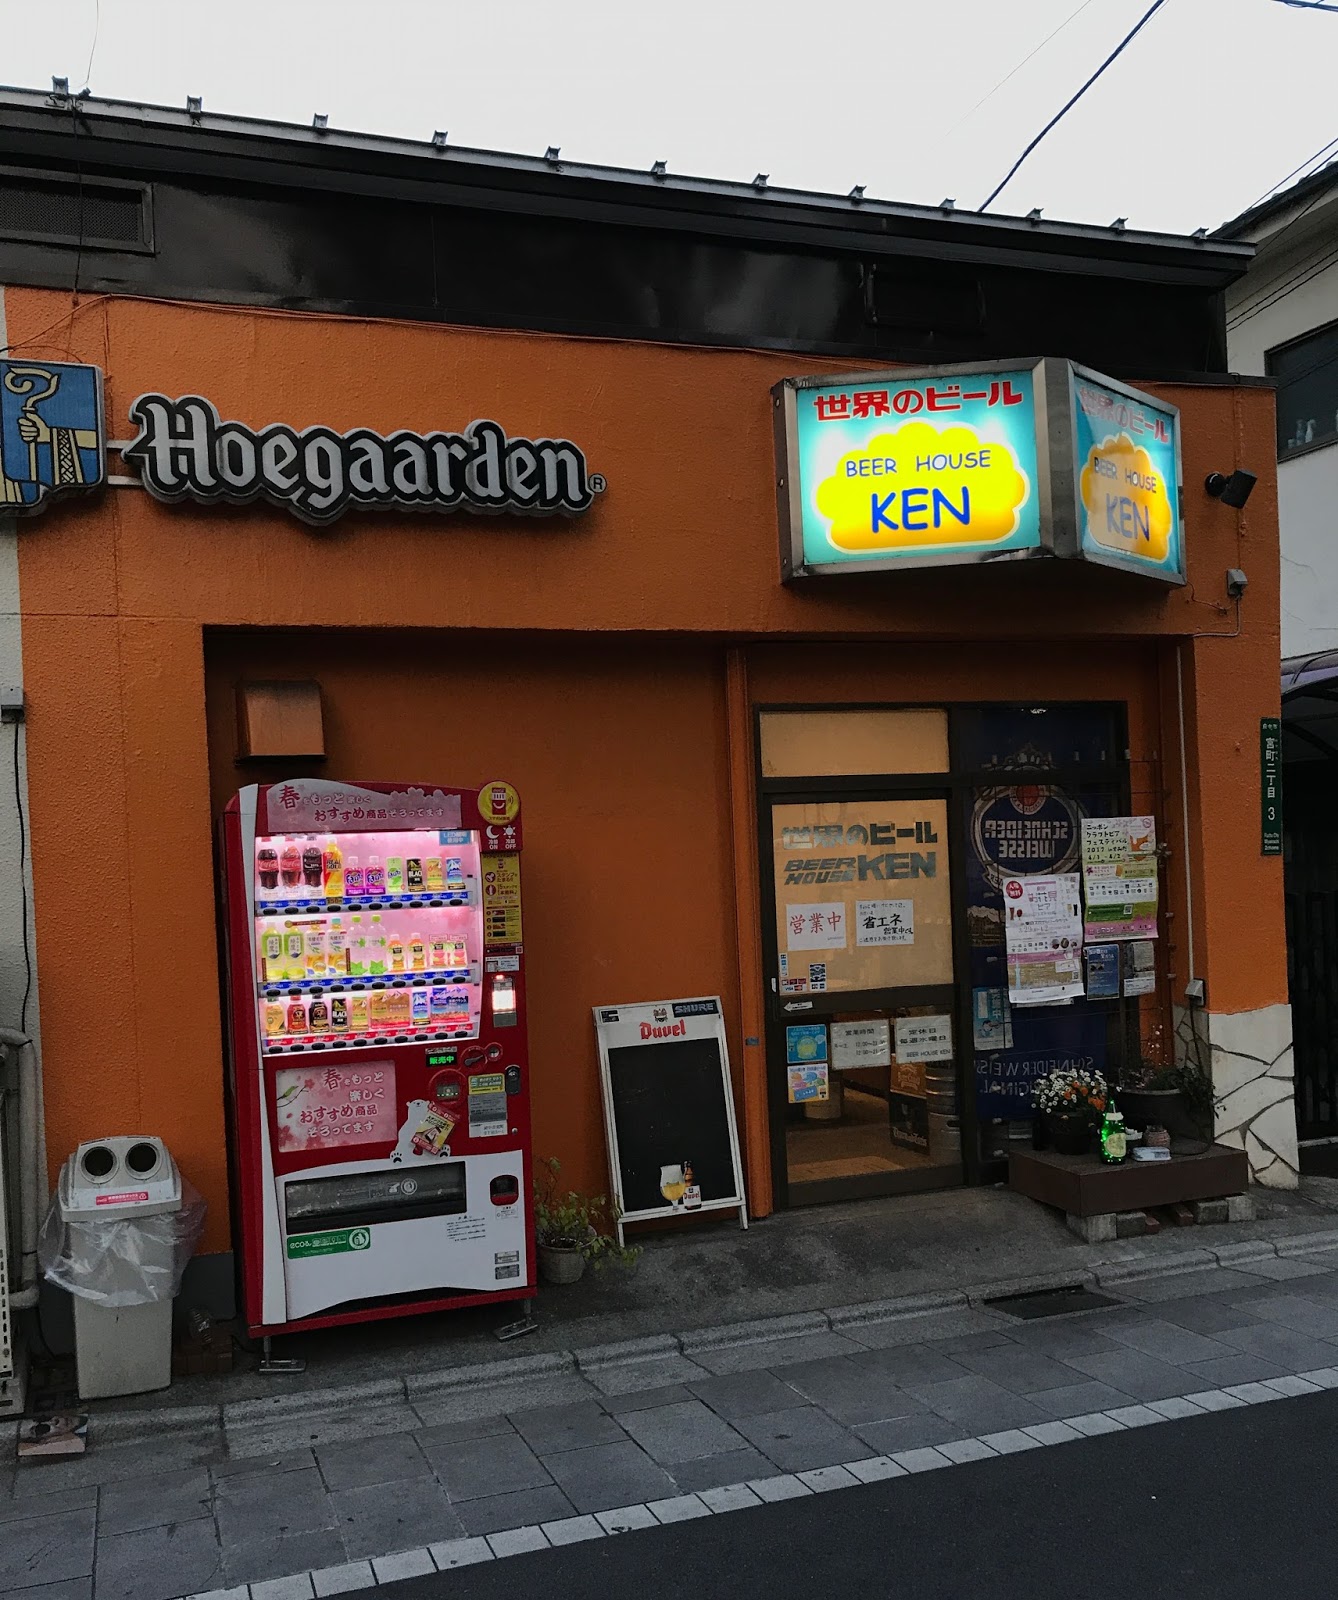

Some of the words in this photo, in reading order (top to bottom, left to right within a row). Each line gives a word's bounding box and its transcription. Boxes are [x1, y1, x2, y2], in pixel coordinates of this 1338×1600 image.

[814, 381, 1022, 422] 世界のビール
[1080, 387, 1169, 443] 世界のビール
[147, 402, 584, 509] Hoegaarden
[846, 457, 897, 477] BEER
[916, 450, 991, 473] HOUSE
[1094, 457, 1117, 480] BEER
[1125, 468, 1157, 493] HOUSE
[870, 486, 971, 534] KEN
[1106, 493, 1150, 541] KEN
[1267, 806, 1276, 821] 3
[782, 821, 938, 850] 世界のビール
[1086, 823, 1109, 831] ニッポン
[1086, 830, 1120, 838] クラフトビア
[1086, 838, 1128, 846] フェスティバル
[784, 856, 856, 872] BEER
[857, 851, 937, 882] KEN
[784, 870, 856, 886] HOUSE
[790, 911, 842, 935] 営業中
[862, 913, 902, 929] 省エネ
[674, 1003, 714, 1014] SHURE
[639, 1018, 687, 1040] Duvel
[908, 1028, 937, 1036] 定休日
[899, 1035, 947, 1044] 毎週水曜日
[429, 1055, 455, 1065] 販売中
[323, 1068, 384, 1091] 春をもっと
[349, 1087, 385, 1102] 楽しく
[299, 1104, 378, 1124] おすすめ商品
[307, 1120, 374, 1137] そろってます
